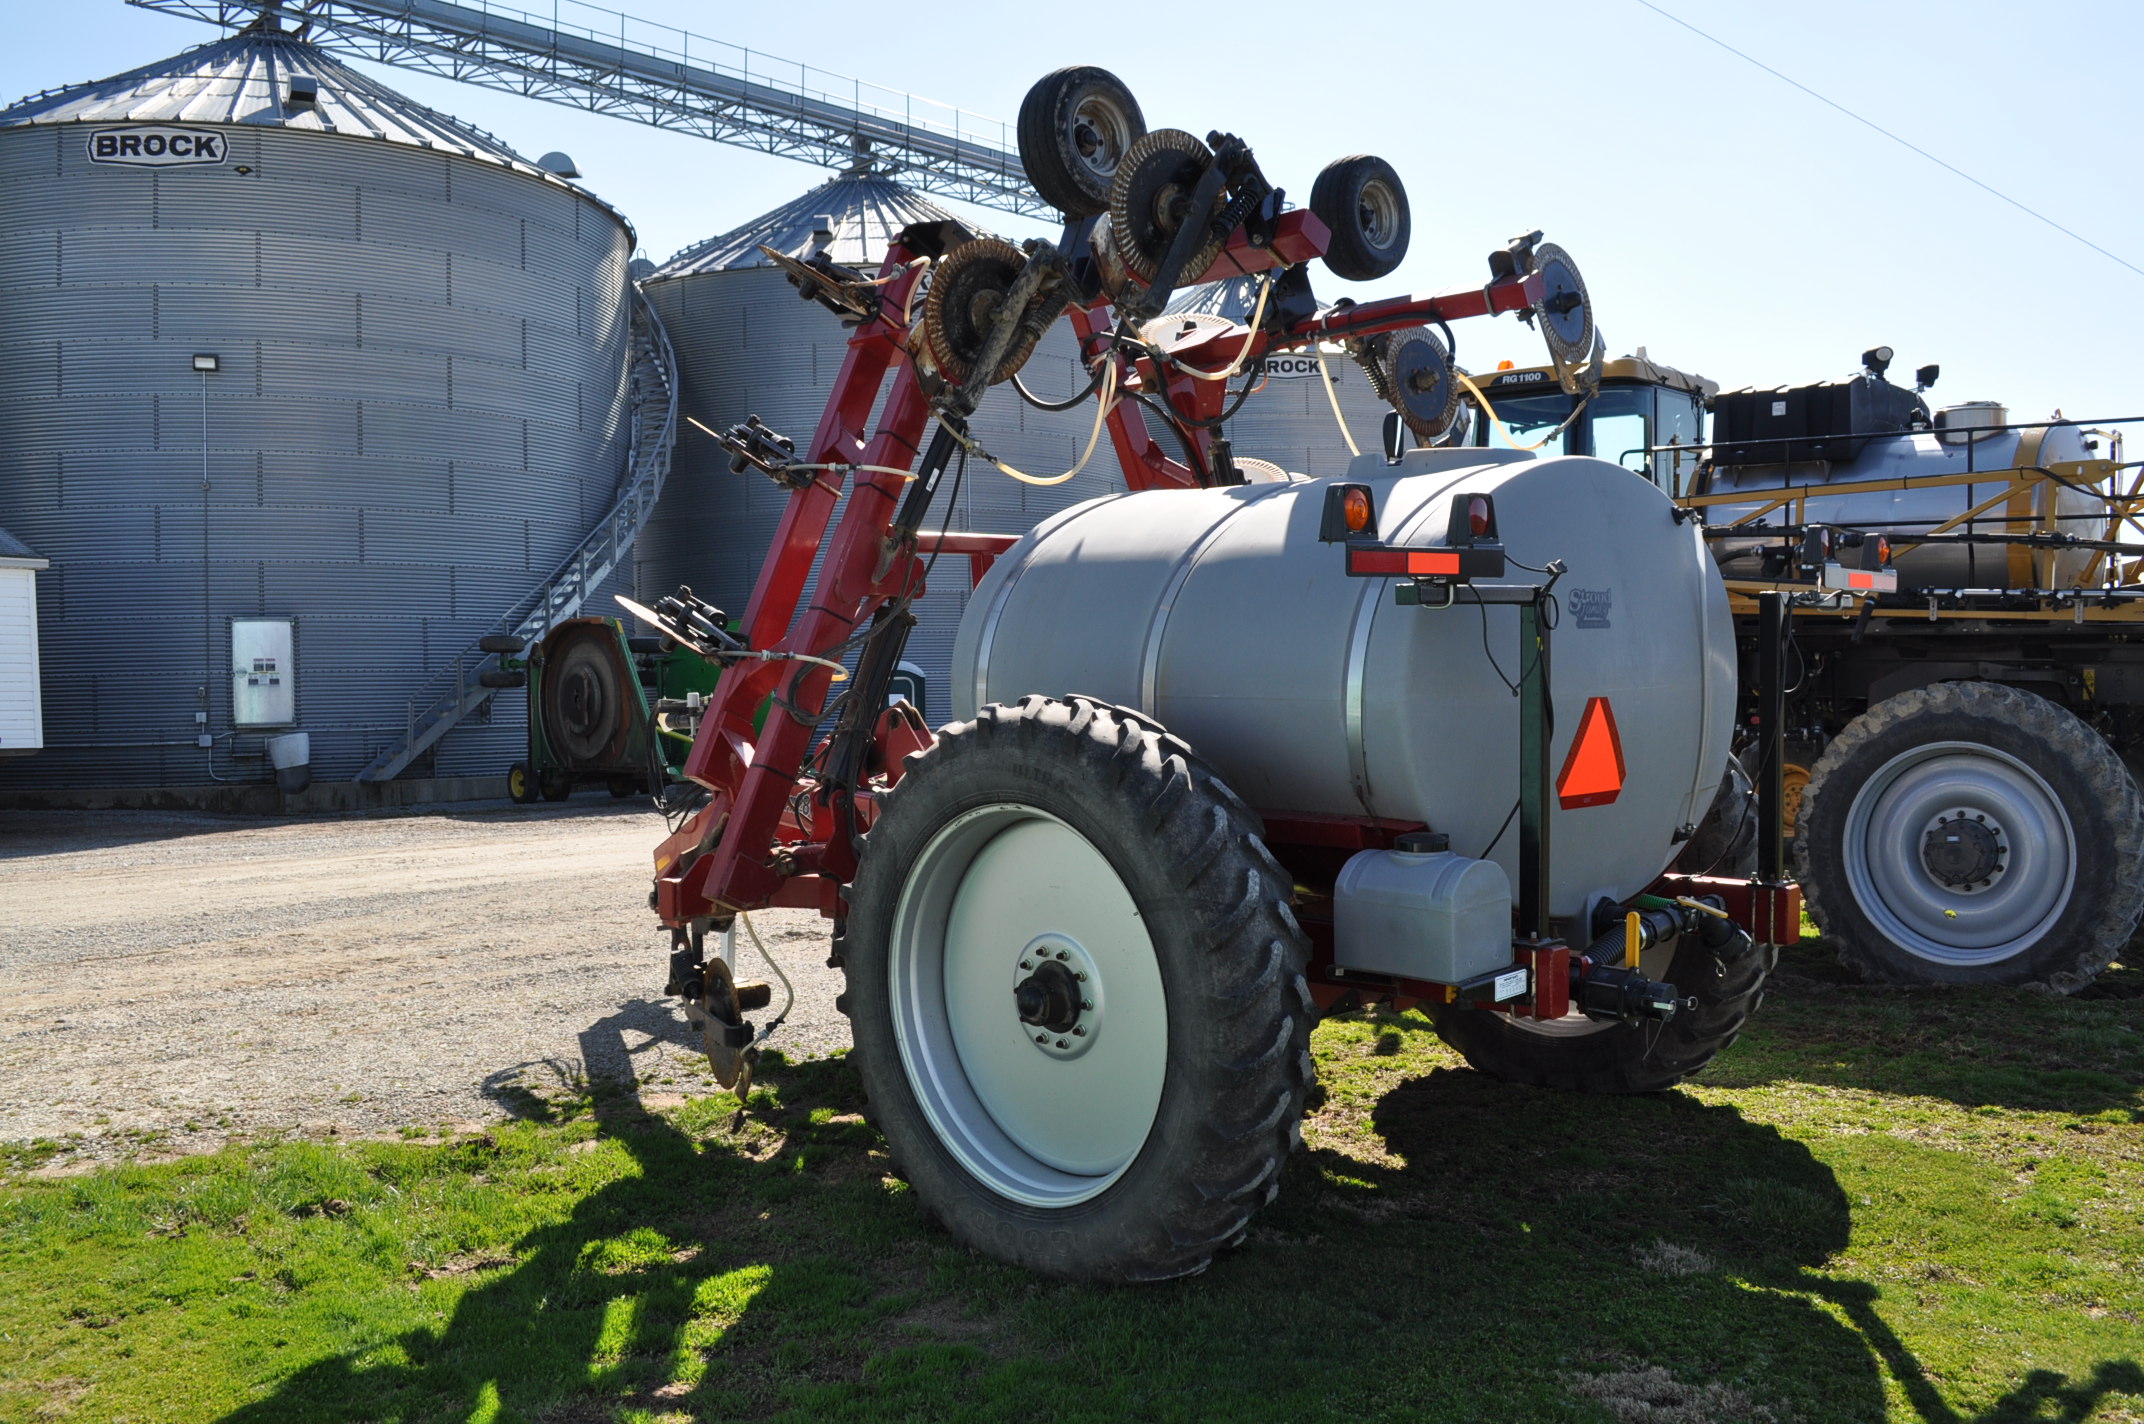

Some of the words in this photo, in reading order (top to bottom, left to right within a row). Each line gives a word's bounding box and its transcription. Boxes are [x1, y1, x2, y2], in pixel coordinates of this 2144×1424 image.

[96, 135, 218, 158] BROCK
[1261, 360, 1320, 373] ROCK
[1502, 374, 1517, 384] RG
[1519, 372, 1541, 382] 1100
